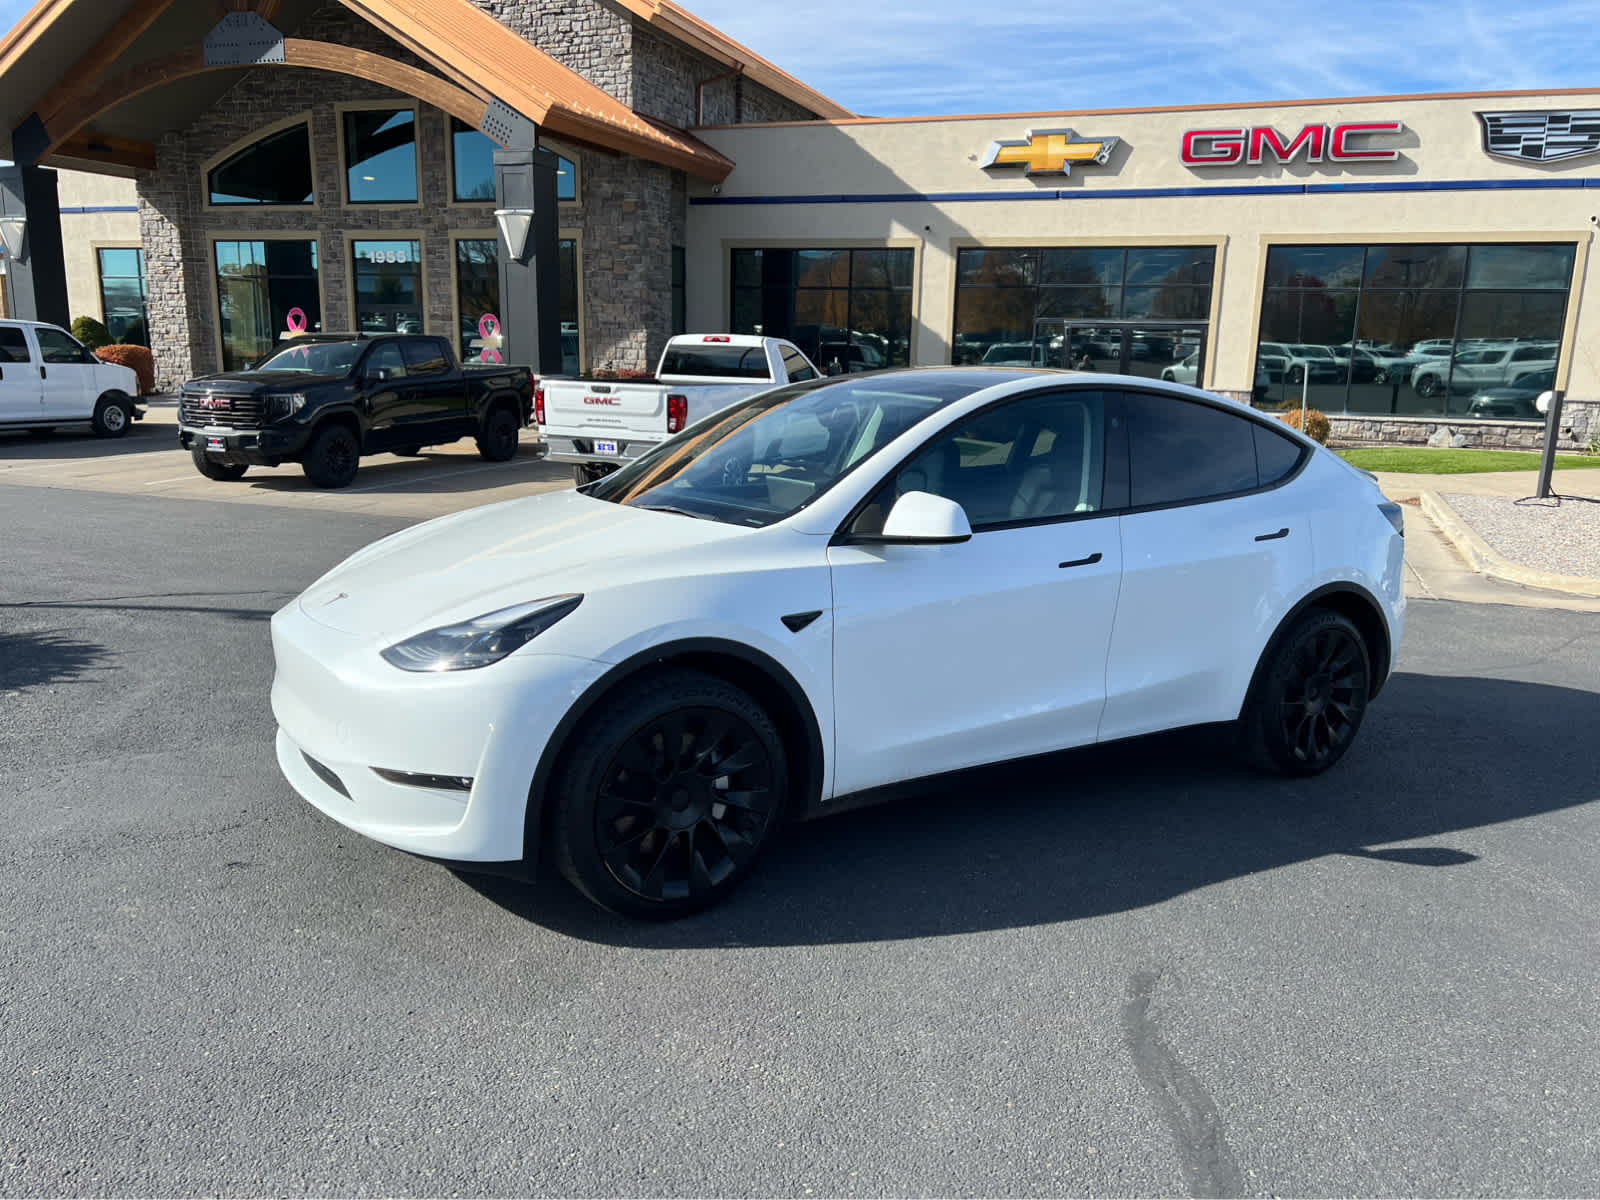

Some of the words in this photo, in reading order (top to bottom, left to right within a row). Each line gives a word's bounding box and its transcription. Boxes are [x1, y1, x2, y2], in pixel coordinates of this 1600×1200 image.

[1180, 121, 1402, 166] GMC
[200, 399, 231, 408] GMC
[583, 396, 621, 406] GMC
